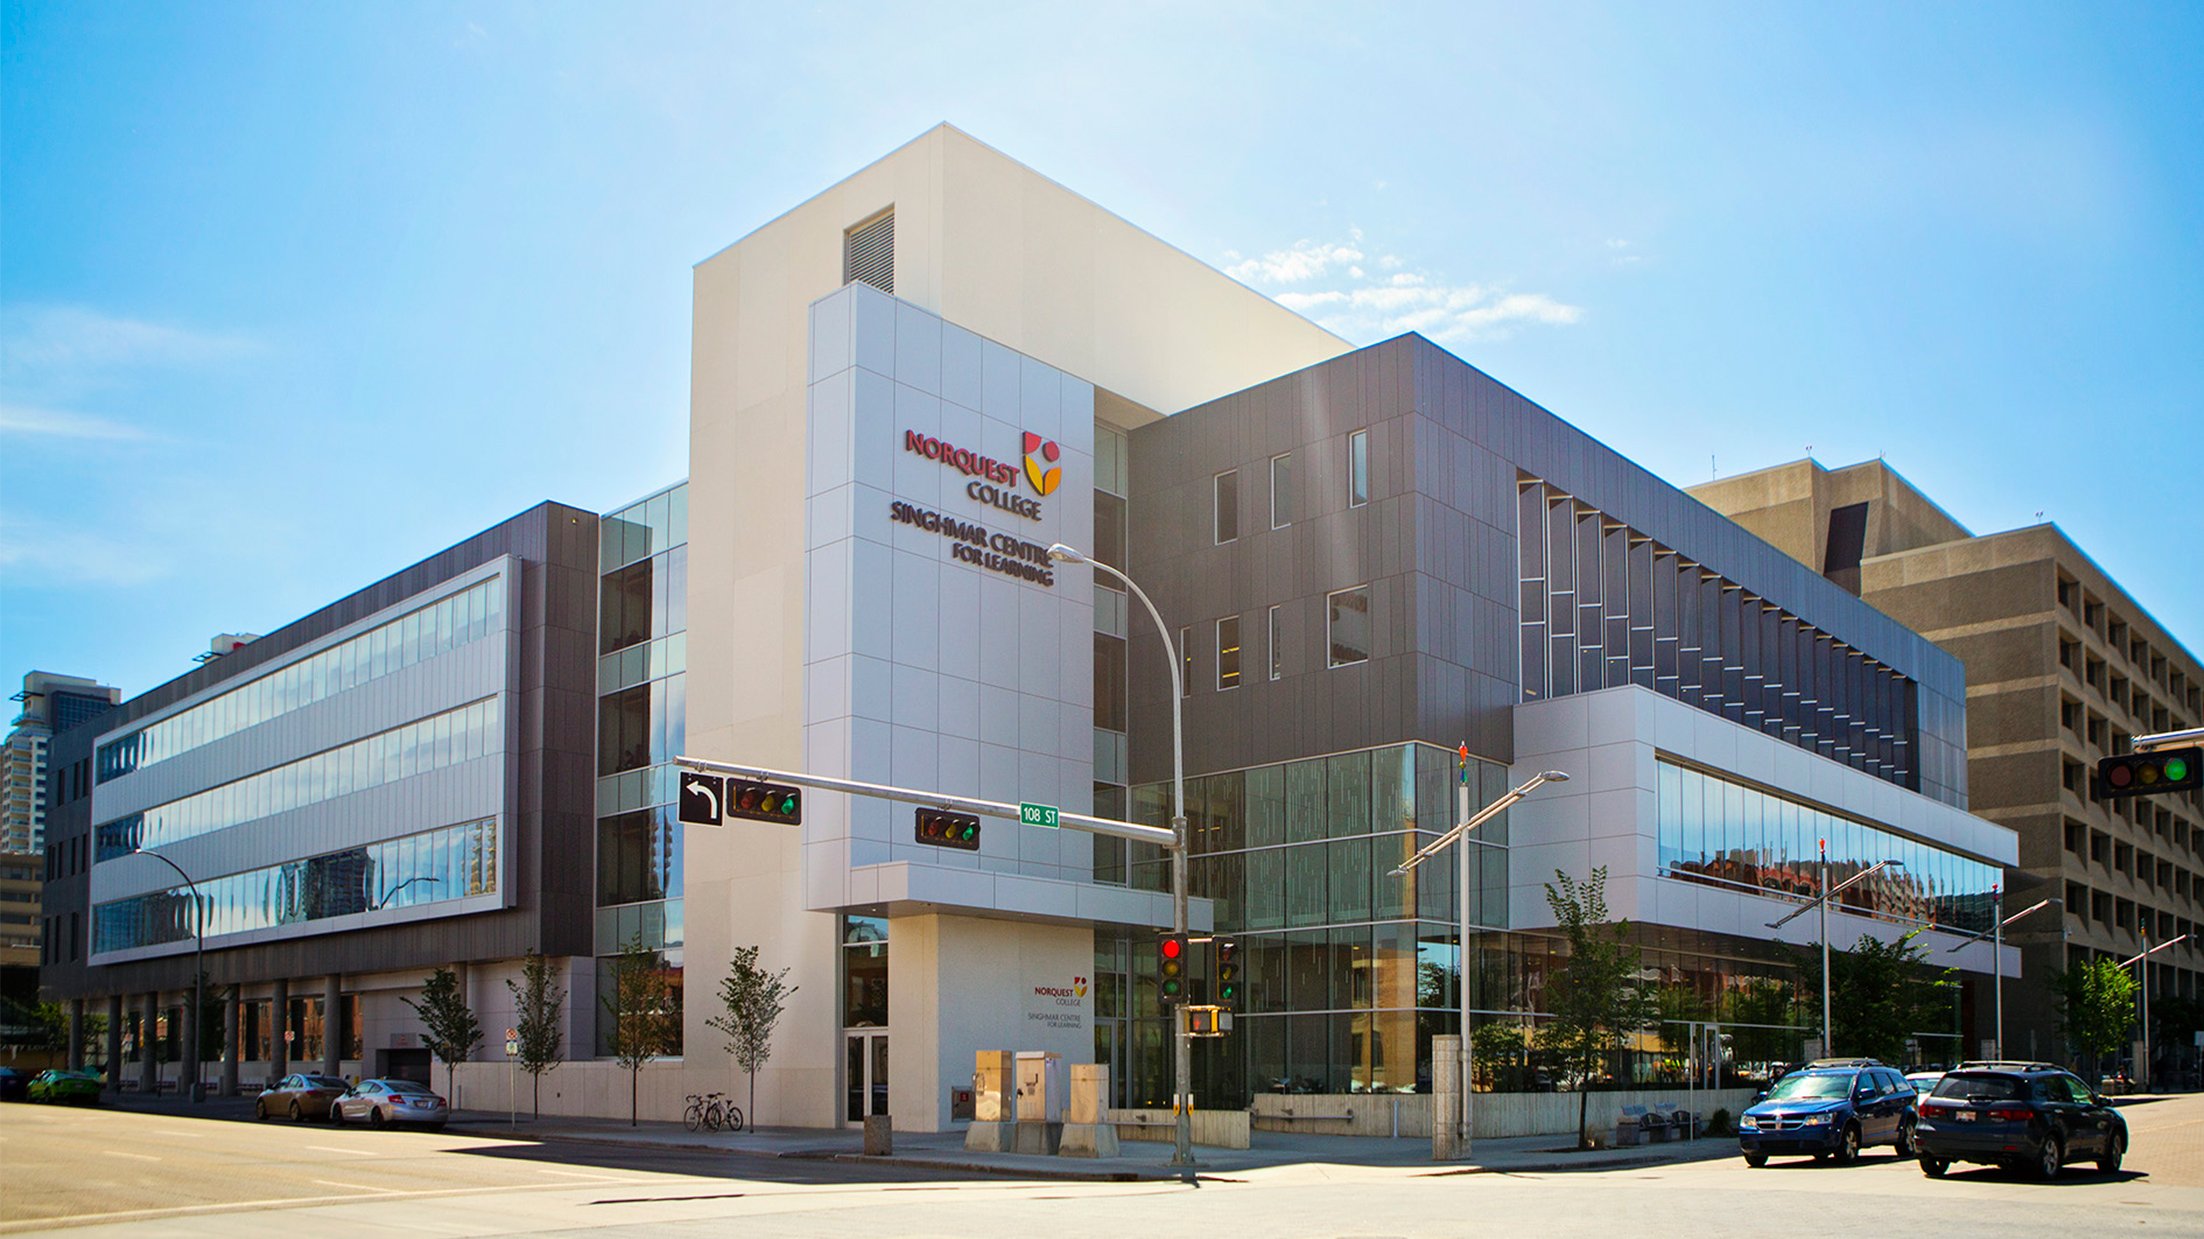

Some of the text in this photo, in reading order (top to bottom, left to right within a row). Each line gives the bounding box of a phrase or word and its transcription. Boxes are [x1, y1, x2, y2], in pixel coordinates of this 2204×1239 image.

[905, 429, 1020, 487] NORQUEST
[967, 481, 1042, 521] COLLEGE
[890, 501, 989, 548] SINGHMAR
[953, 542, 1054, 587] FOR LEARNING
[1024, 807, 1056, 824] 108 ST
[1034, 987, 1073, 998] NORQUEST
[1055, 998, 1081, 1007] COLLEGE
